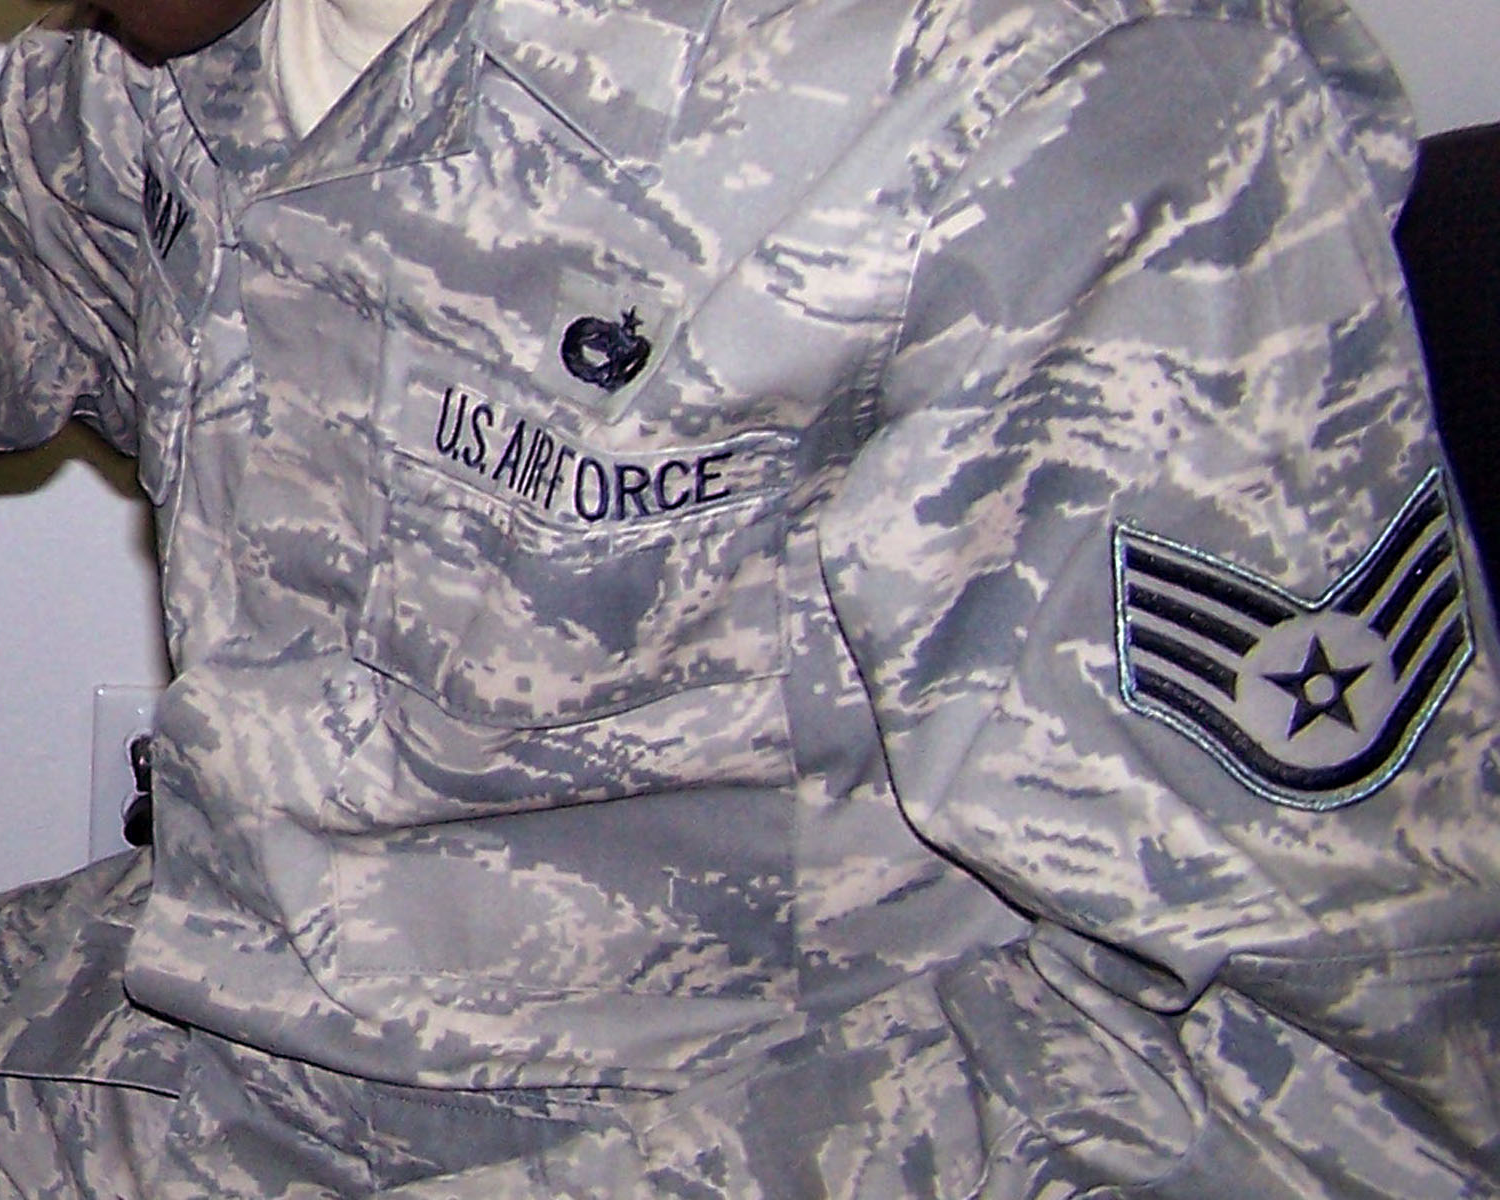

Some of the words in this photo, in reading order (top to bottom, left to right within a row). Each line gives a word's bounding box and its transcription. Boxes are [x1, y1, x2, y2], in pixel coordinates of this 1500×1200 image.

[435, 387, 494, 475] U.S.
[492, 418, 554, 501] AIR
[543, 443, 734, 523] FORCE
